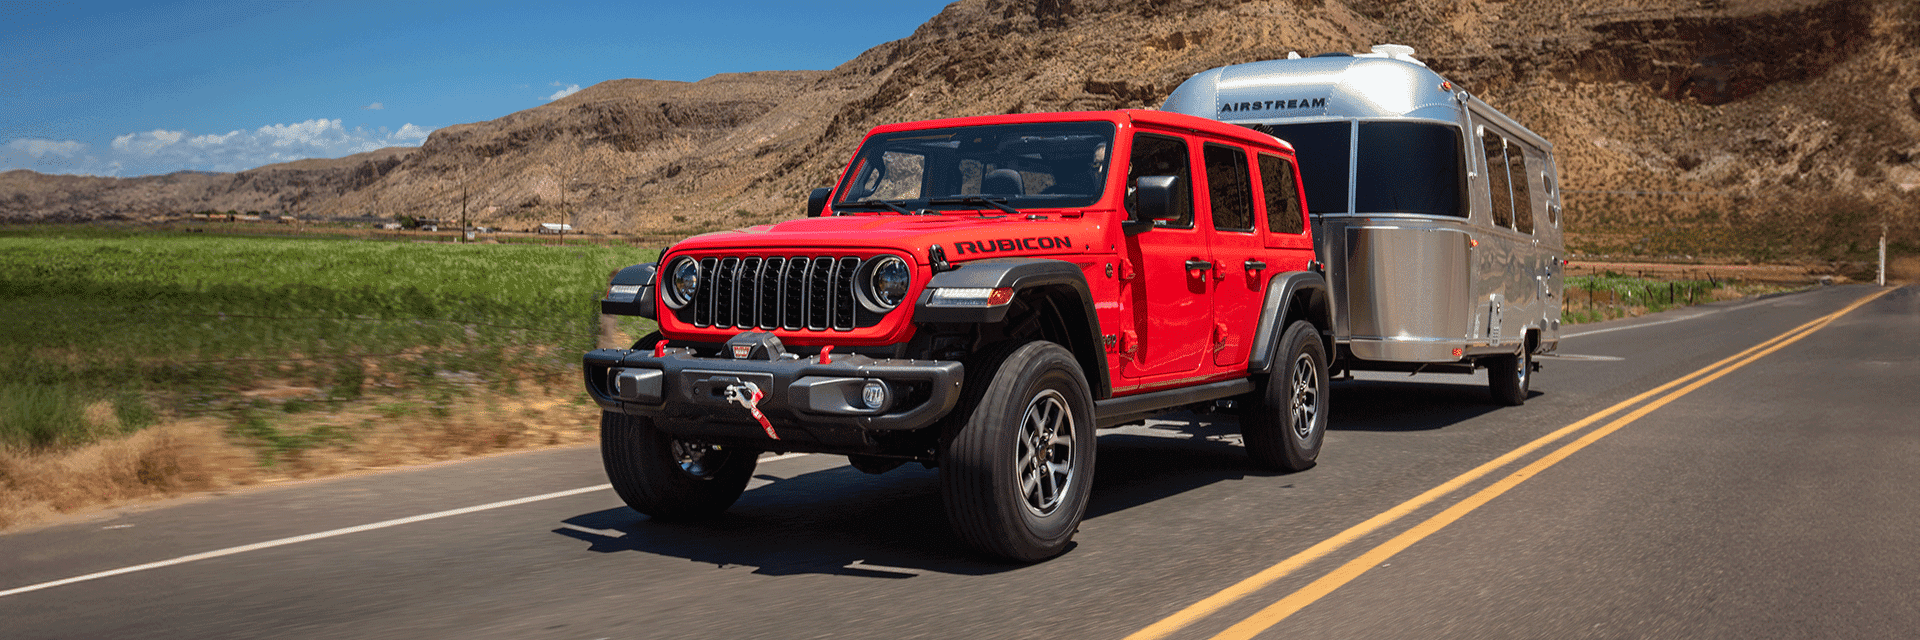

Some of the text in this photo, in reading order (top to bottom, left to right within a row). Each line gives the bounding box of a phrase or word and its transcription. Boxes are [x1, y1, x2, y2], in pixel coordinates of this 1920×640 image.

[1221, 97, 1325, 112] AIRSTREAM
[954, 236, 1072, 254] RUBICON
[1101, 334, 1117, 348] eep
